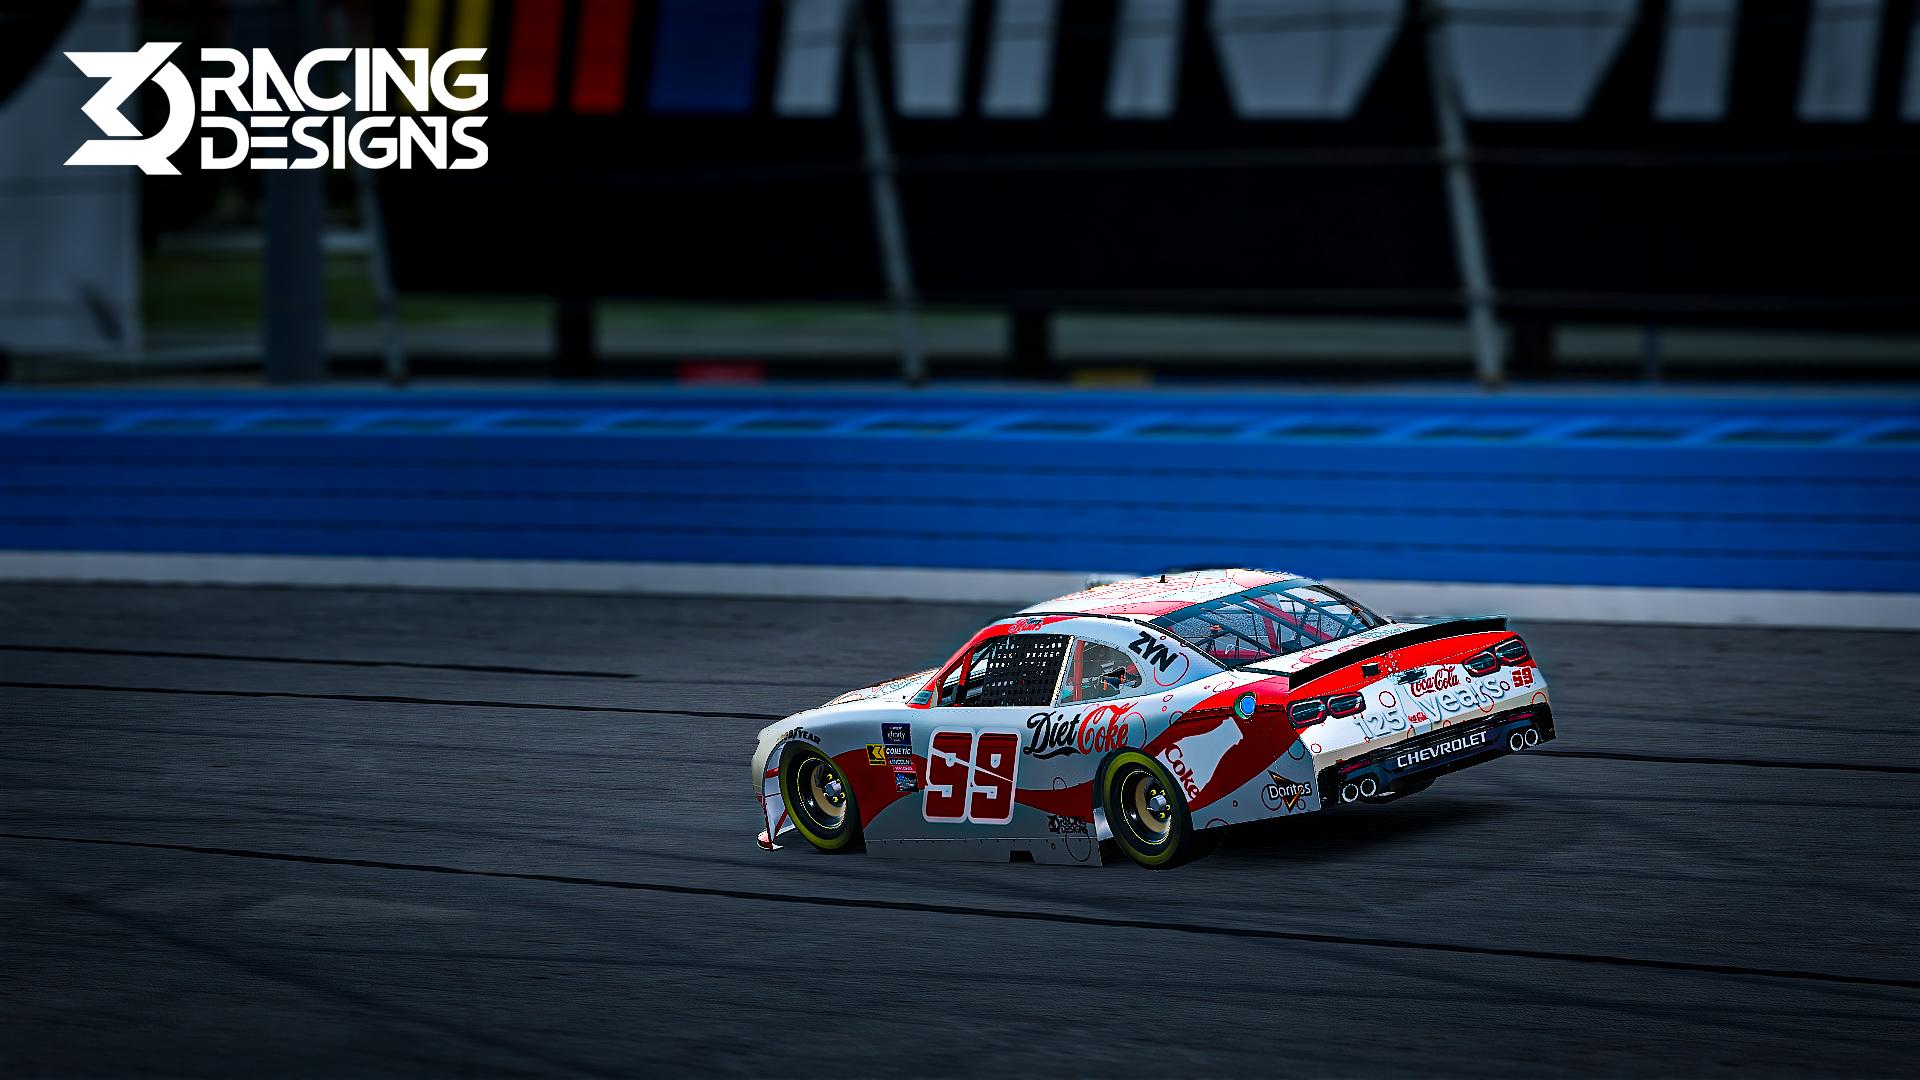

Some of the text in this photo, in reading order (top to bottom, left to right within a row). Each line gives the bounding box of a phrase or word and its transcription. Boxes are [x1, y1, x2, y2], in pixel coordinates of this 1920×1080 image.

[1128, 631, 1178, 672] ZYN
[1023, 702, 1138, 759] Diet Coke
[1355, 677, 1505, 738] 125 years
[923, 727, 1020, 823] 99
[1165, 743, 1200, 799] Coke
[1397, 731, 1487, 767] CHEVROLET
[1269, 783, 1311, 798] Doritos
